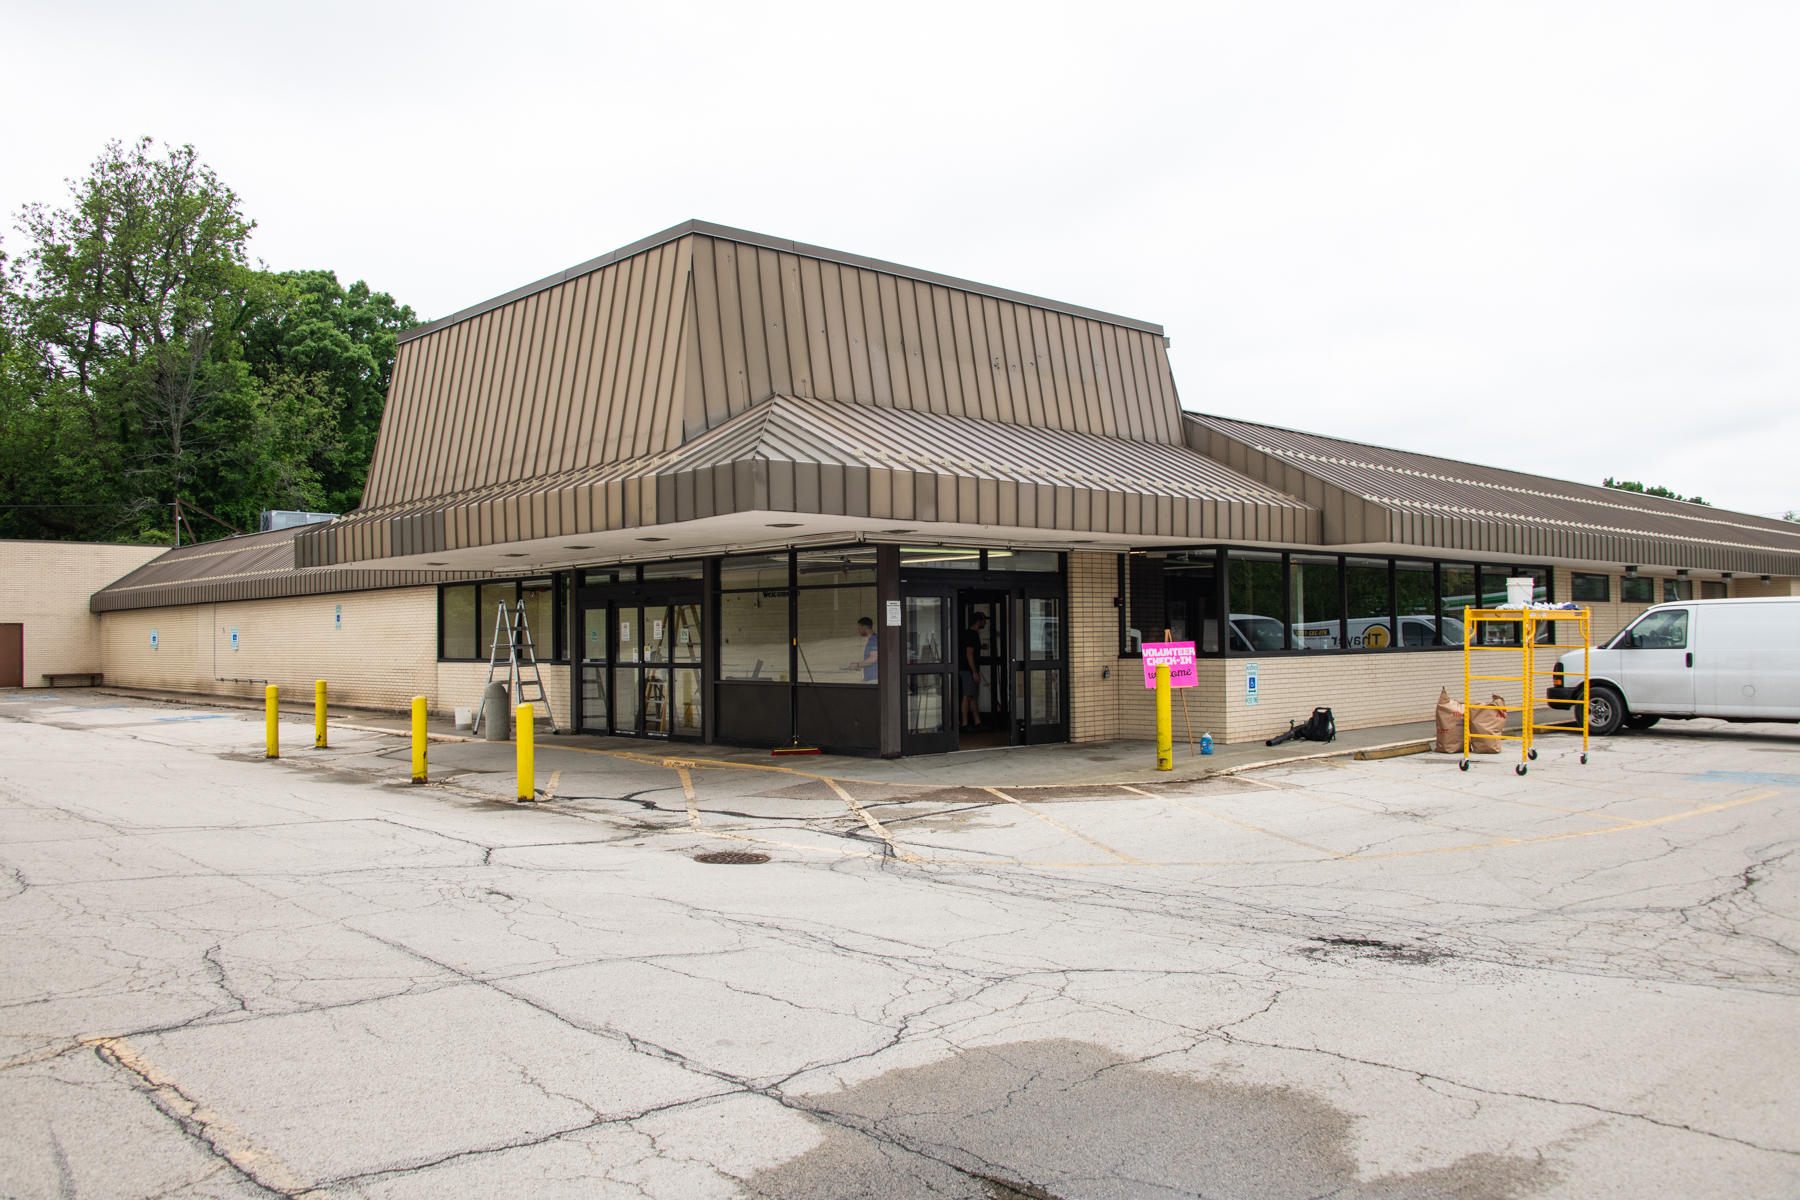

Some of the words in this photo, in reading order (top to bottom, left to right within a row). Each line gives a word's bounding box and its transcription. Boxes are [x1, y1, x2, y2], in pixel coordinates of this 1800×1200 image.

[1142, 647, 1195, 657] VOLUNTEER
[1147, 656, 1192, 666] CHECK-IN
[1148, 668, 1192, 679] wome
